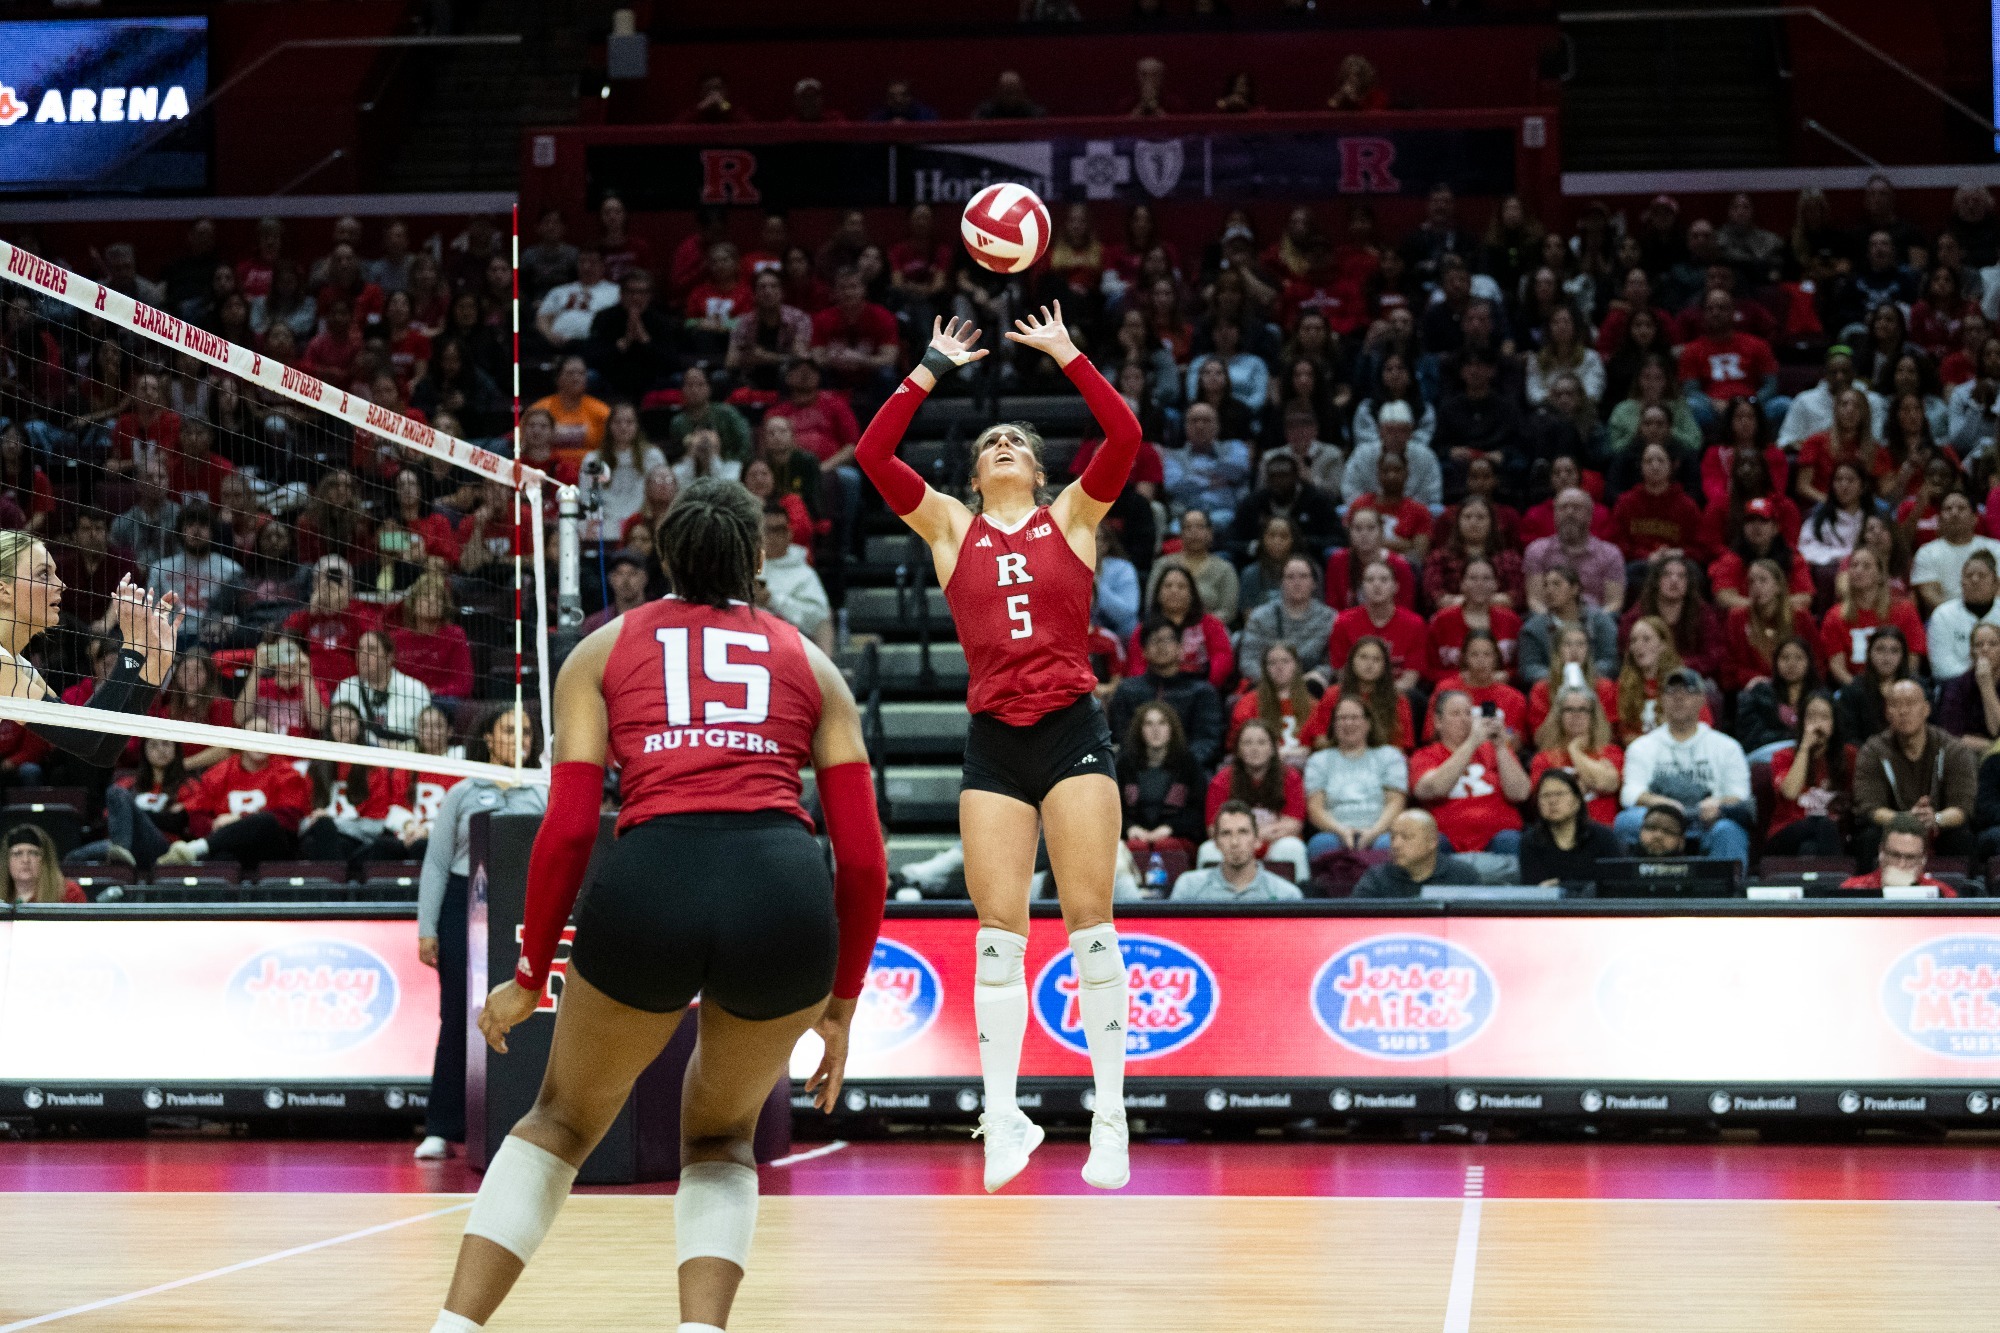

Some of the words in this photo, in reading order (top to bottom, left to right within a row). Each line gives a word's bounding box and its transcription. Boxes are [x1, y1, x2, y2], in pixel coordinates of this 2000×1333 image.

[34, 86, 190, 123] ARENA
[1337, 136, 1398, 193] R
[701, 149, 760, 204] R
[8, 246, 68, 295] RUTGERS
[94, 284, 107, 311] R
[133, 300, 182, 342] SCARLET
[185, 323, 229, 363] KNIGHTS
[251, 353, 262, 376] R
[281, 365, 323, 402] RUTGERS
[340, 392, 350, 413] R
[365, 403, 402, 437] SCARLET
[996, 553, 1034, 587] R
[1006, 594, 1033, 640] 5
[655, 627, 771, 727] 15
[644, 729, 780, 754] RUTGERS
[245, 958, 378, 1002] Jersey
[1336, 956, 1475, 1001] Jersey
[1902, 955, 2000, 992] Jers
[1377, 1035, 1432, 1051] SUBS
[46, 1092, 104, 1106] Prudential
[166, 1092, 224, 1107] Prudential
[287, 1092, 346, 1107] Prudential
[869, 1094, 930, 1108] Prudential
[1229, 1094, 1292, 1108] Prudential
[1353, 1094, 1417, 1108] Prudential
[1479, 1095, 1543, 1109] Prudential
[1605, 1095, 1669, 1110] Prudential
[1733, 1095, 1797, 1110] Prudential
[1863, 1096, 1927, 1111] Prudential
